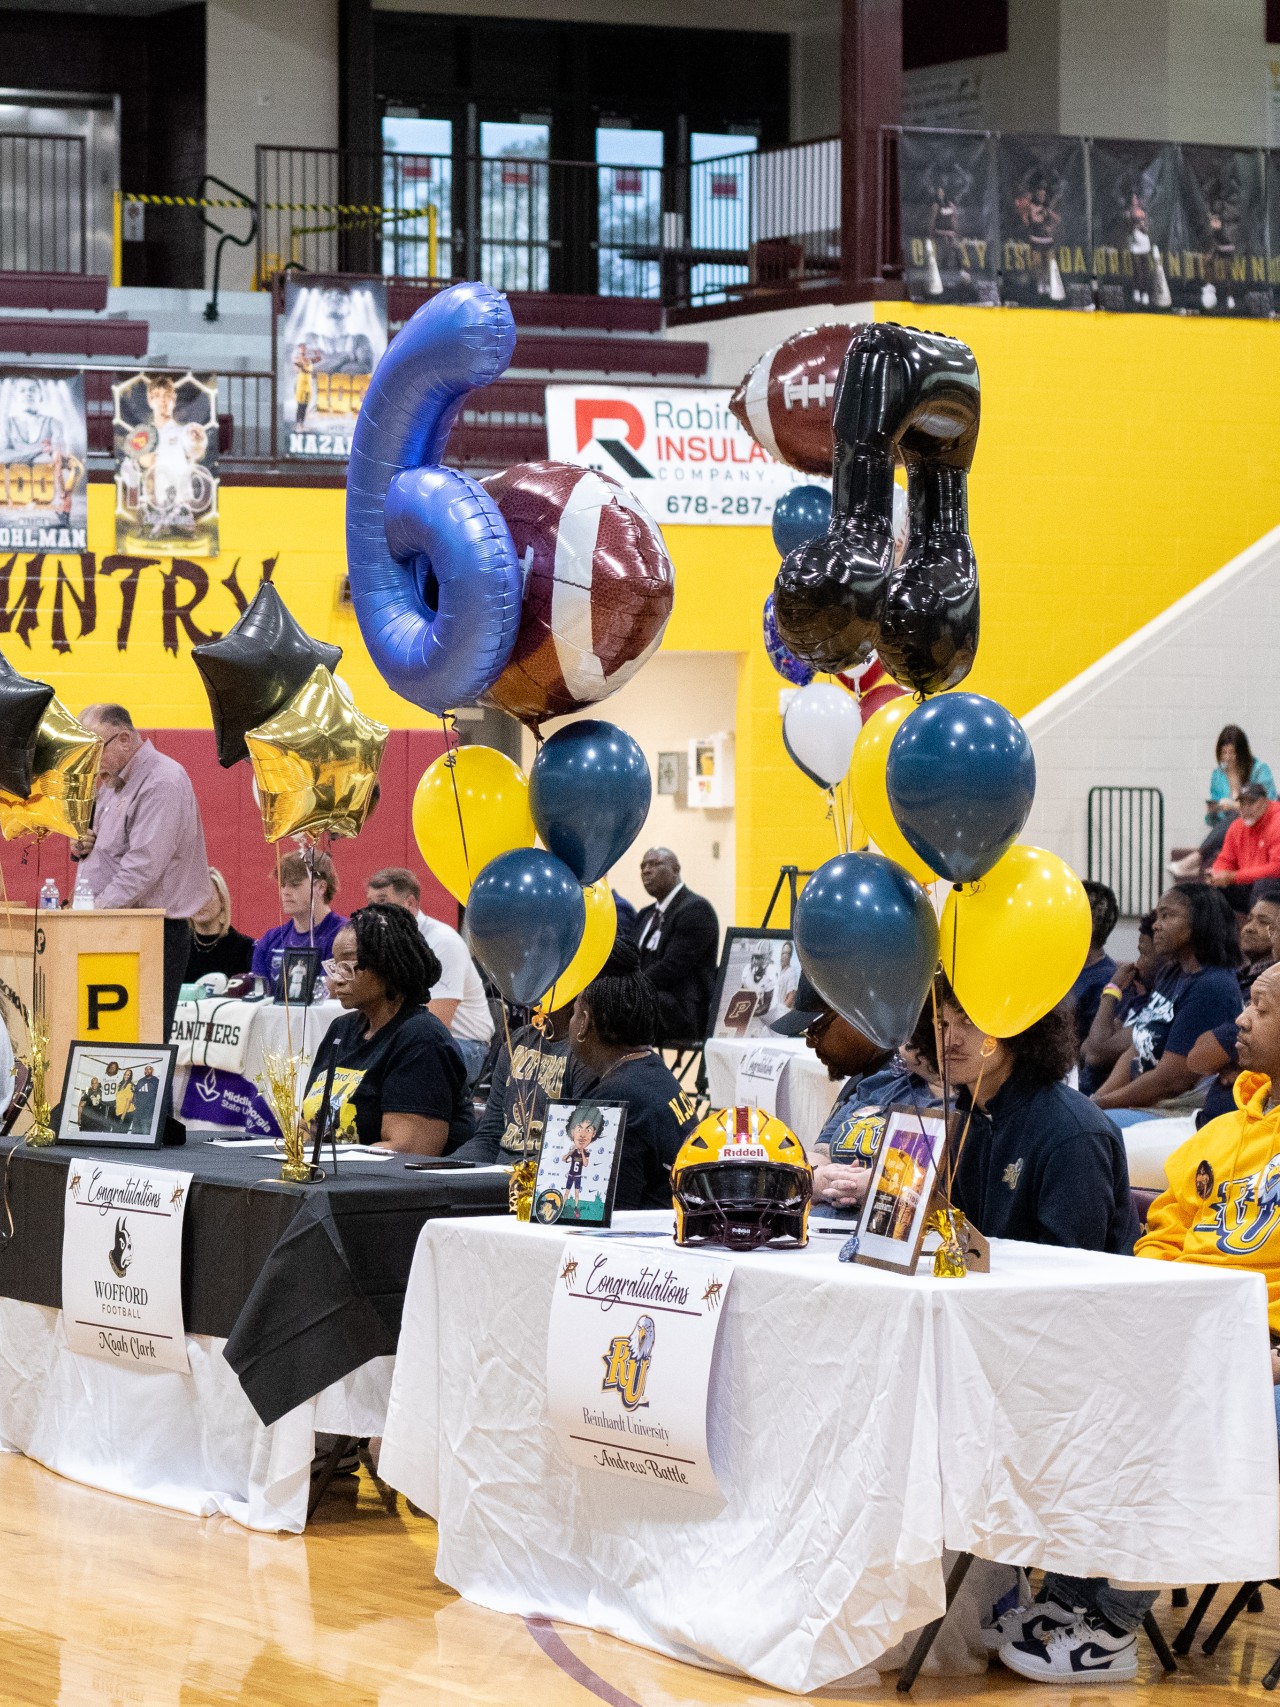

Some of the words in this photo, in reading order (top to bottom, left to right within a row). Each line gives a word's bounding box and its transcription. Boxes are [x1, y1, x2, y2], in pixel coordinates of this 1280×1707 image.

[657, 436, 777, 464] INSULA
[667, 495, 778, 515] 678-287-
[86, 983, 129, 1031] P
[170, 1020, 241, 1047] PANTHERS
[103, 1082, 117, 1096] 99
[723, 1148, 764, 1158] Riddell
[573, 1161, 581, 1173] 6
[87, 1166, 162, 1217] Congratulations
[94, 1280, 148, 1306] WOFFORD
[586, 1253, 690, 1312] Congratulations
[101, 1303, 141, 1319] FOOTBALL
[99, 1331, 129, 1357] Noah
[130, 1336, 157, 1360] Clark
[582, 1406, 626, 1433] Reinhardt
[626, 1416, 670, 1447] University
[594, 1449, 646, 1476] Andrew
[645, 1459, 689, 1485] Battle
